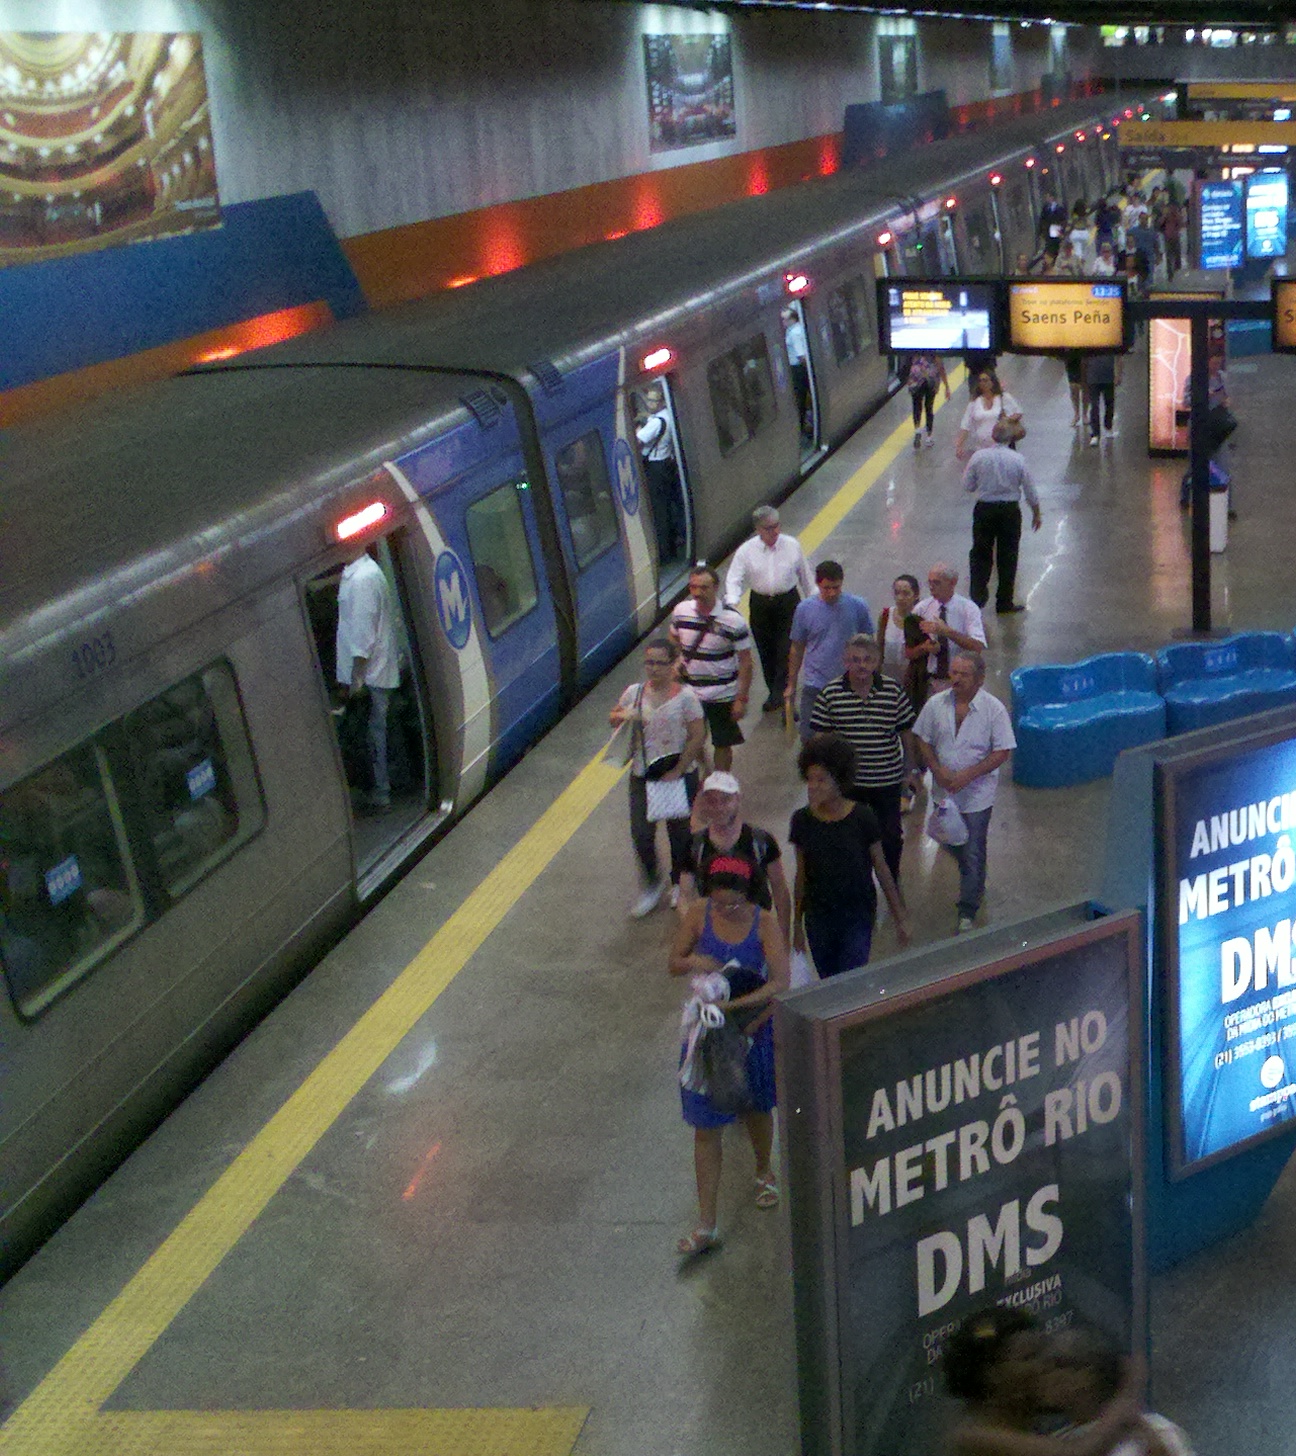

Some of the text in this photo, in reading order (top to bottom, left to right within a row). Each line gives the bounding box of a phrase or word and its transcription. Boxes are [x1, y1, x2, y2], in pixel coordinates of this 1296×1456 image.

[1022, 310, 1110, 324] Saens Peña
[1179, 834, 1296, 924] METRÔ
[866, 1010, 1107, 1140] ANUNCIE NO
[850, 1071, 1122, 1227] METRÔ RIO
[917, 1184, 1064, 1318] DMS
